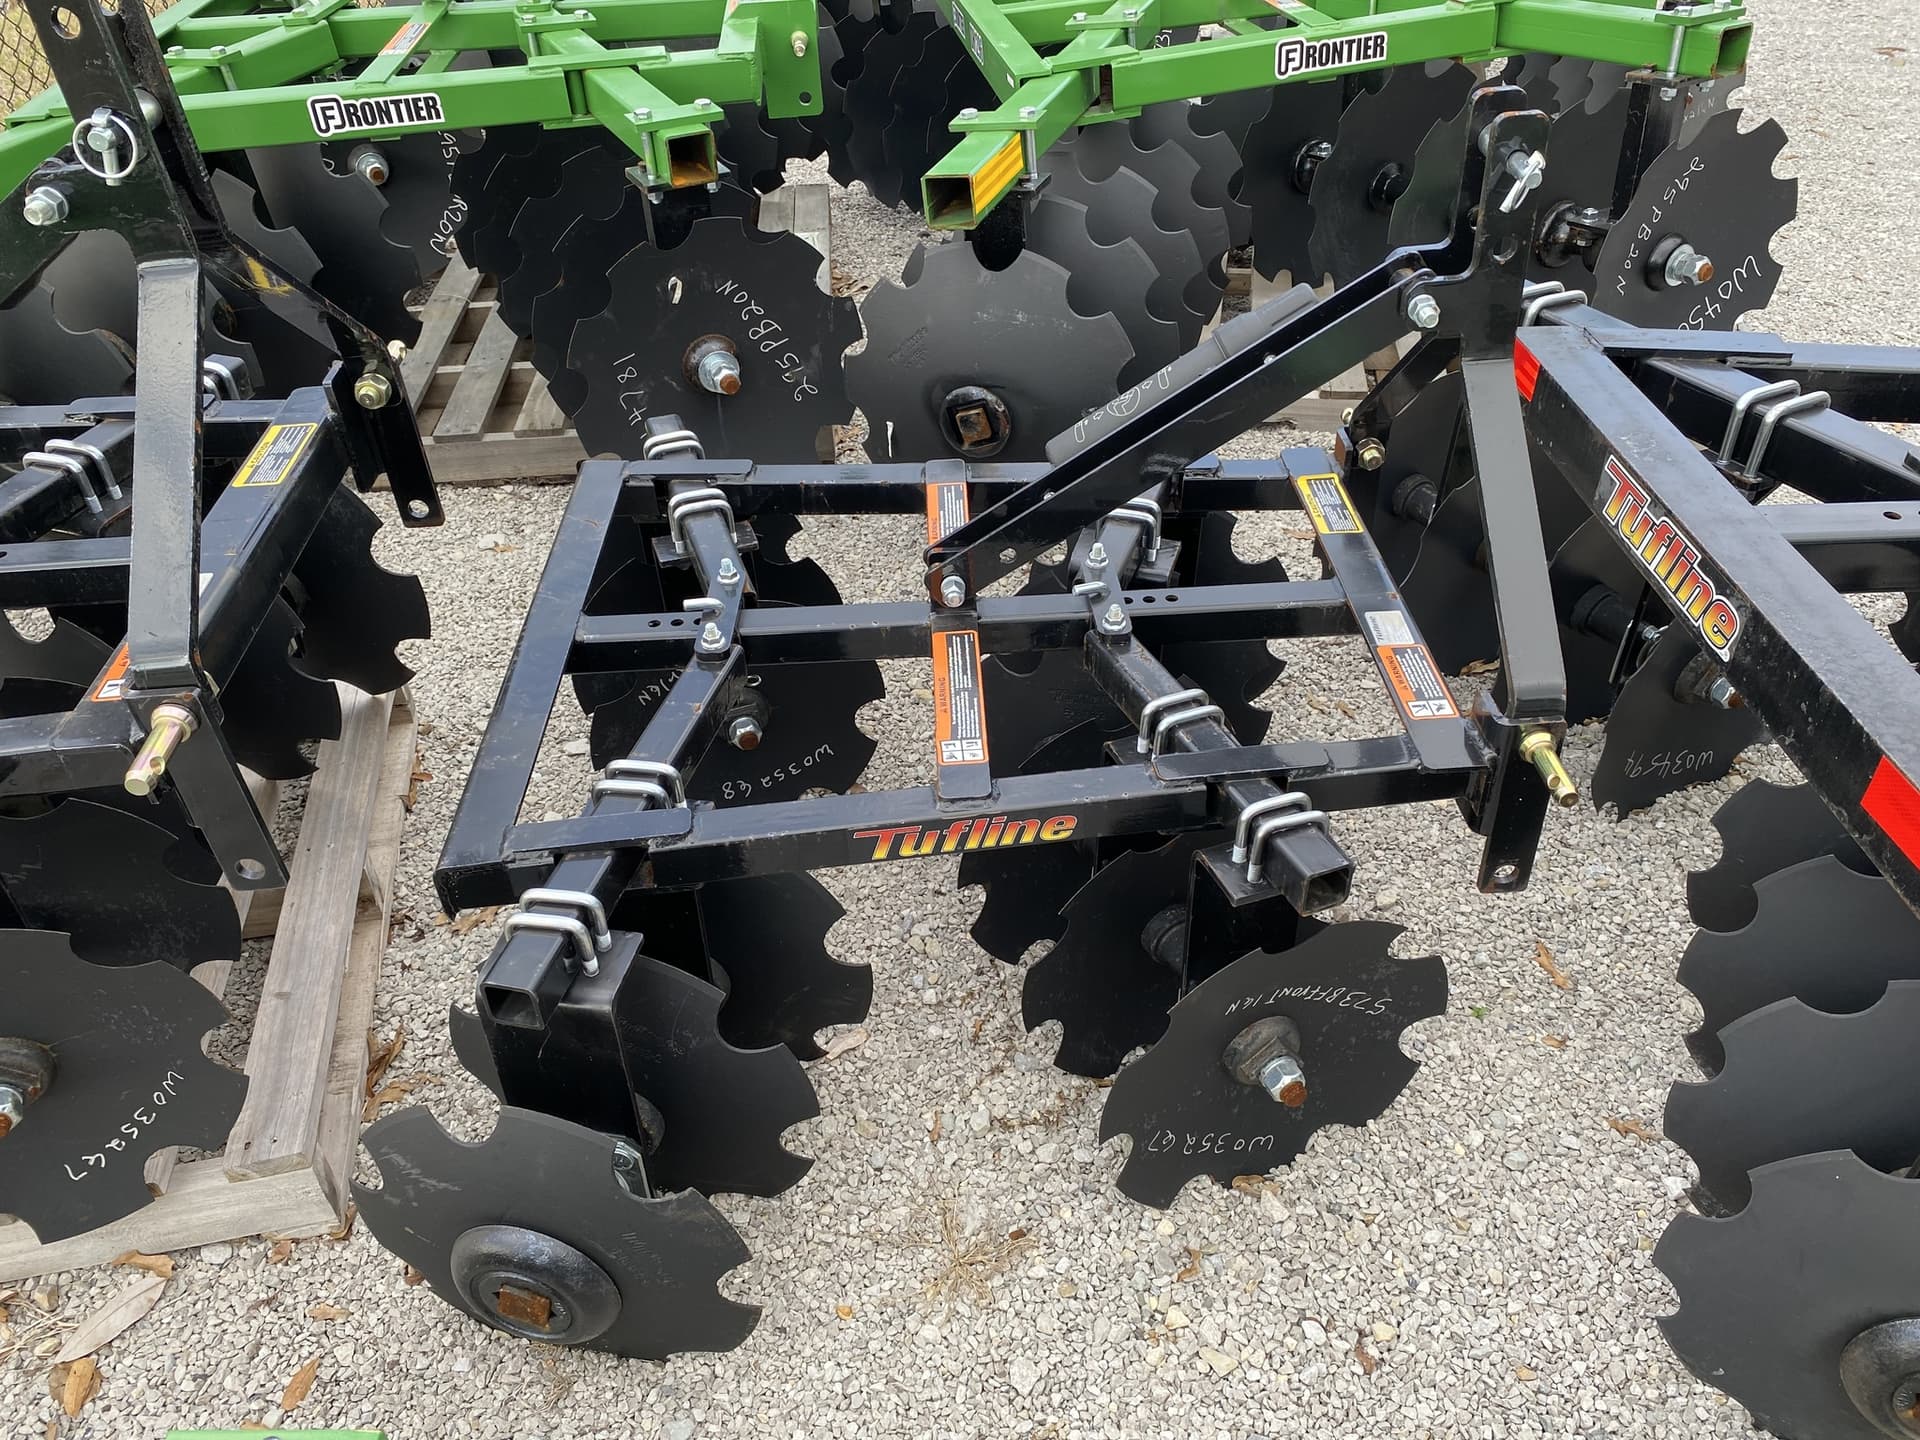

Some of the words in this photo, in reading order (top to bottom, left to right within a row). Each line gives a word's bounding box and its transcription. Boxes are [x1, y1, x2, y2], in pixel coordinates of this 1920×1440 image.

[1278, 35, 1385, 76] FRONTIER
[310, 96, 441, 133] FRONTIER
[1604, 458, 1738, 649] Tufline
[854, 815, 1078, 860] Tufline
